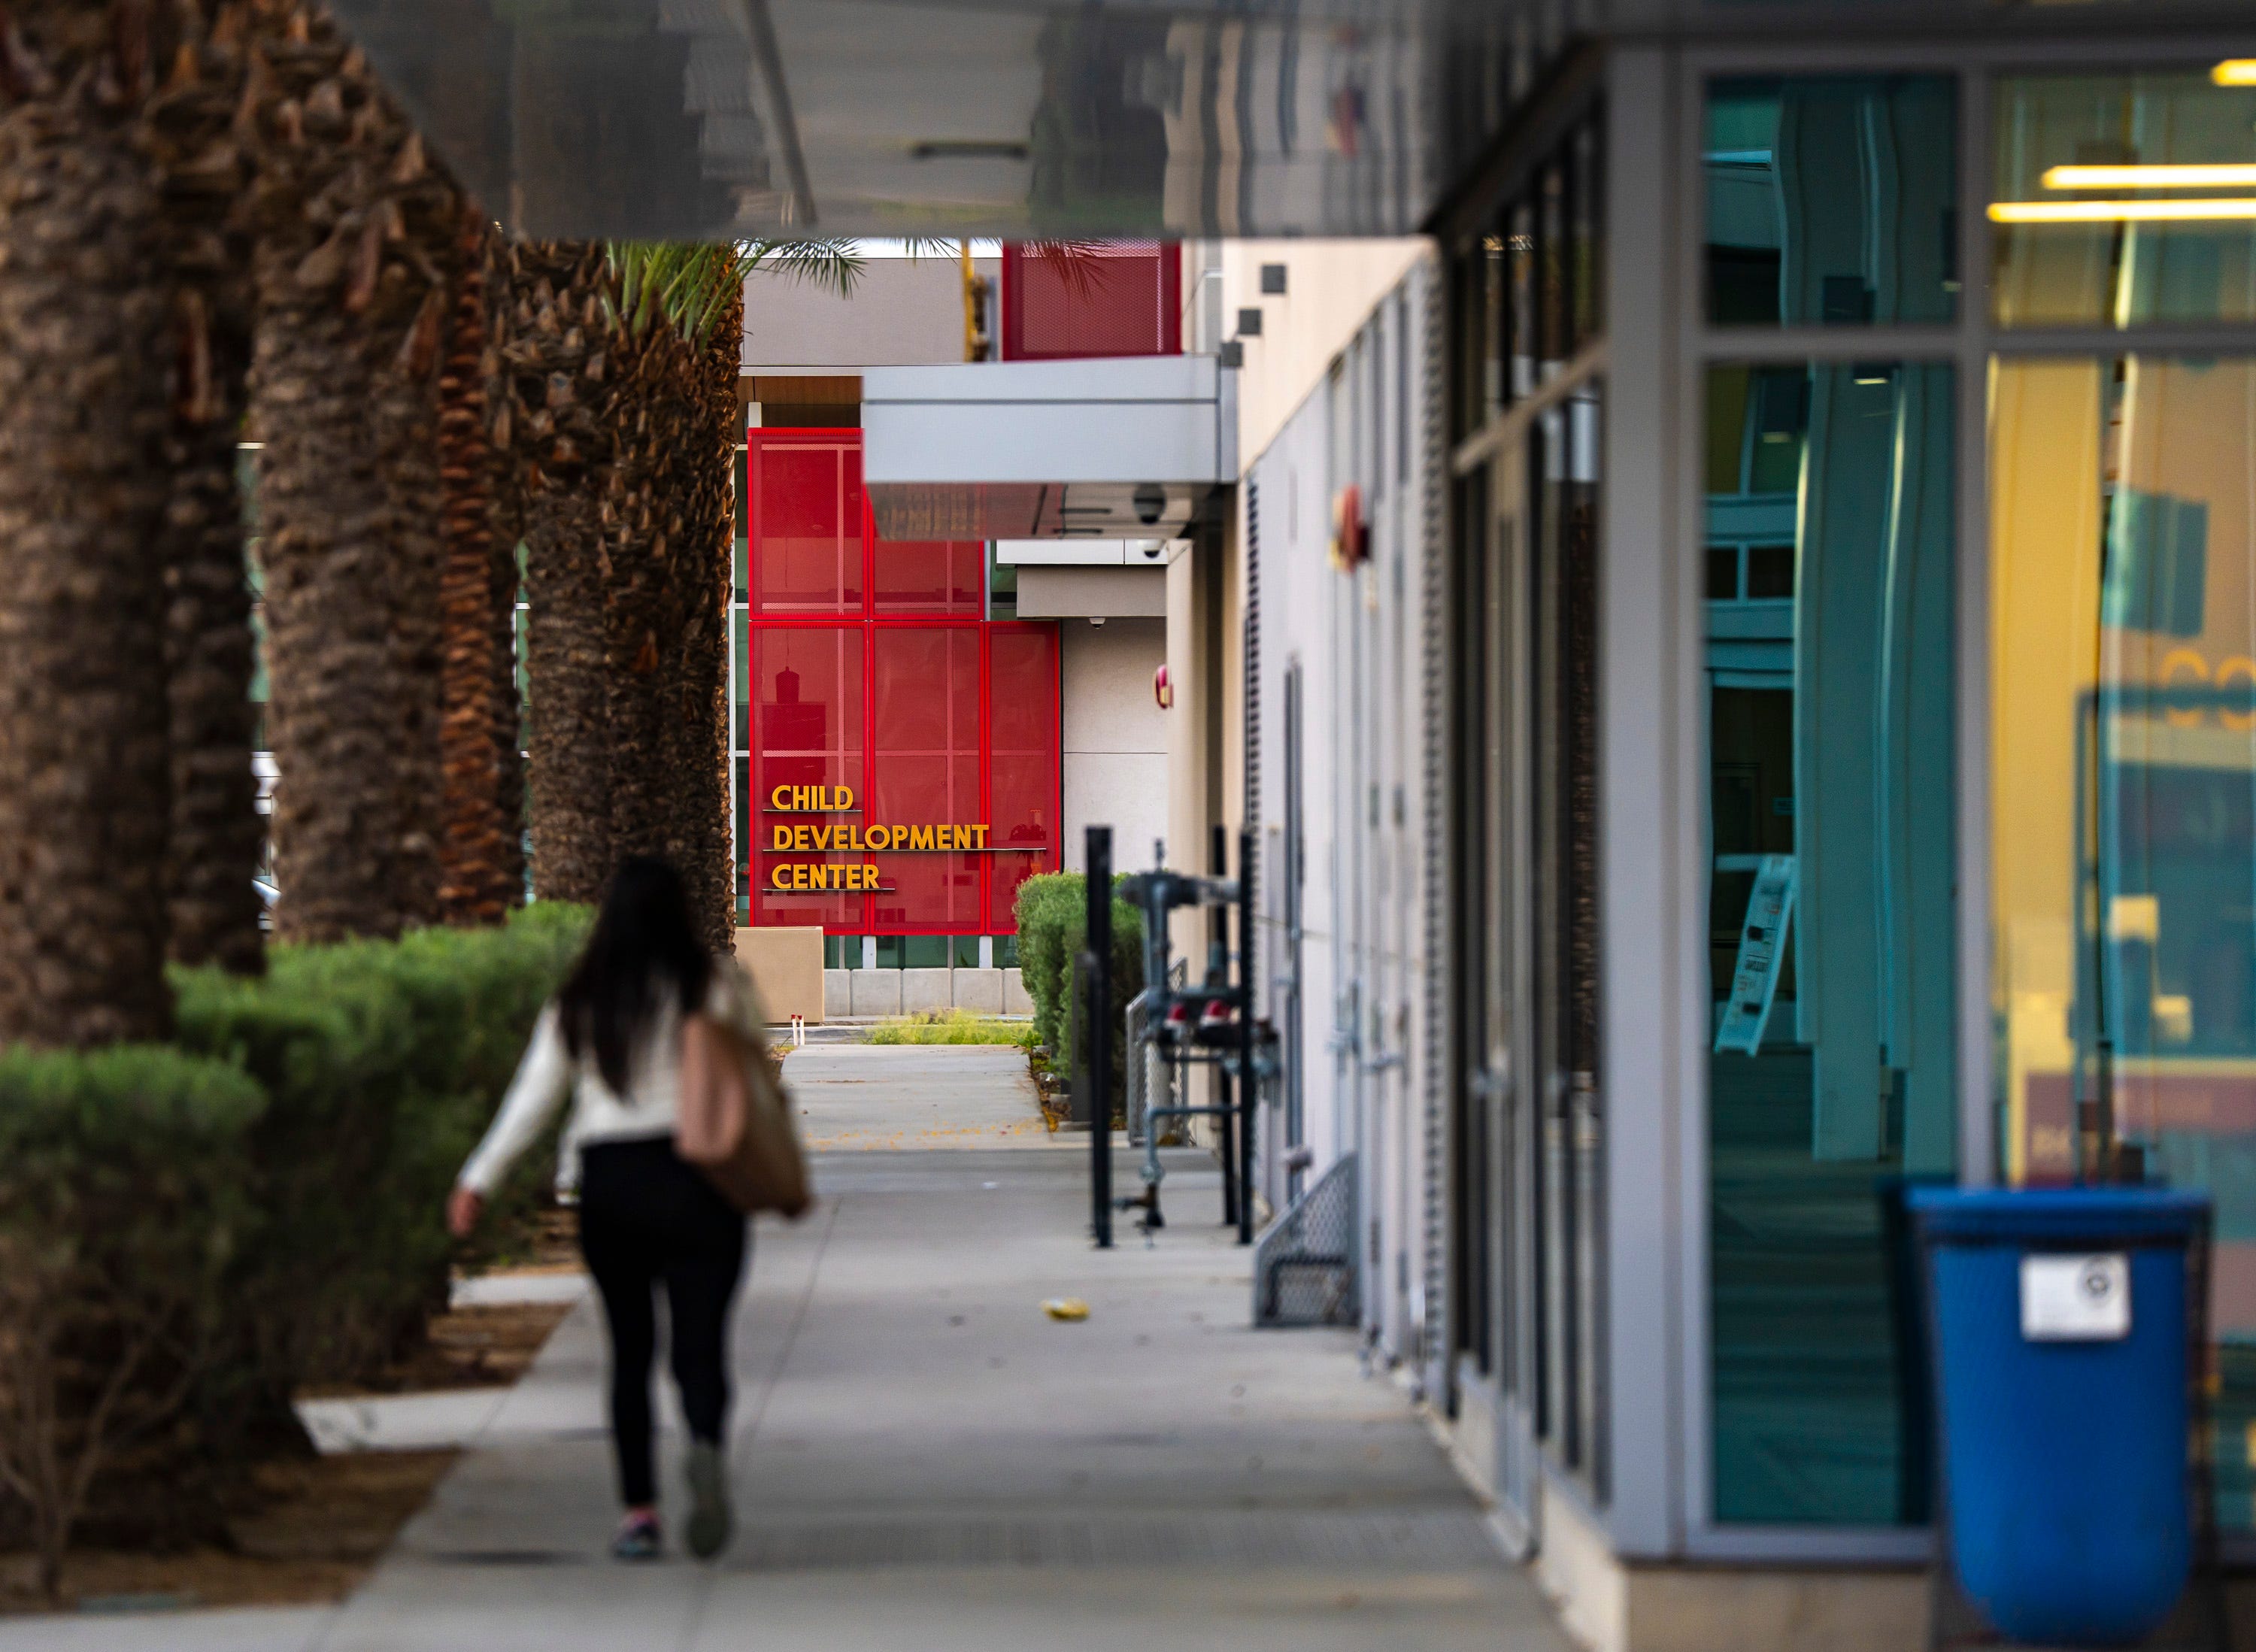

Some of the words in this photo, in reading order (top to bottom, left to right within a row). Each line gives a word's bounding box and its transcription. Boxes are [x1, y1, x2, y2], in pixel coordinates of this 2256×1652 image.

[772, 784, 854, 811] CHILD
[774, 824, 990, 850] DEVELOPMENT
[772, 863, 880, 890] CENTER
